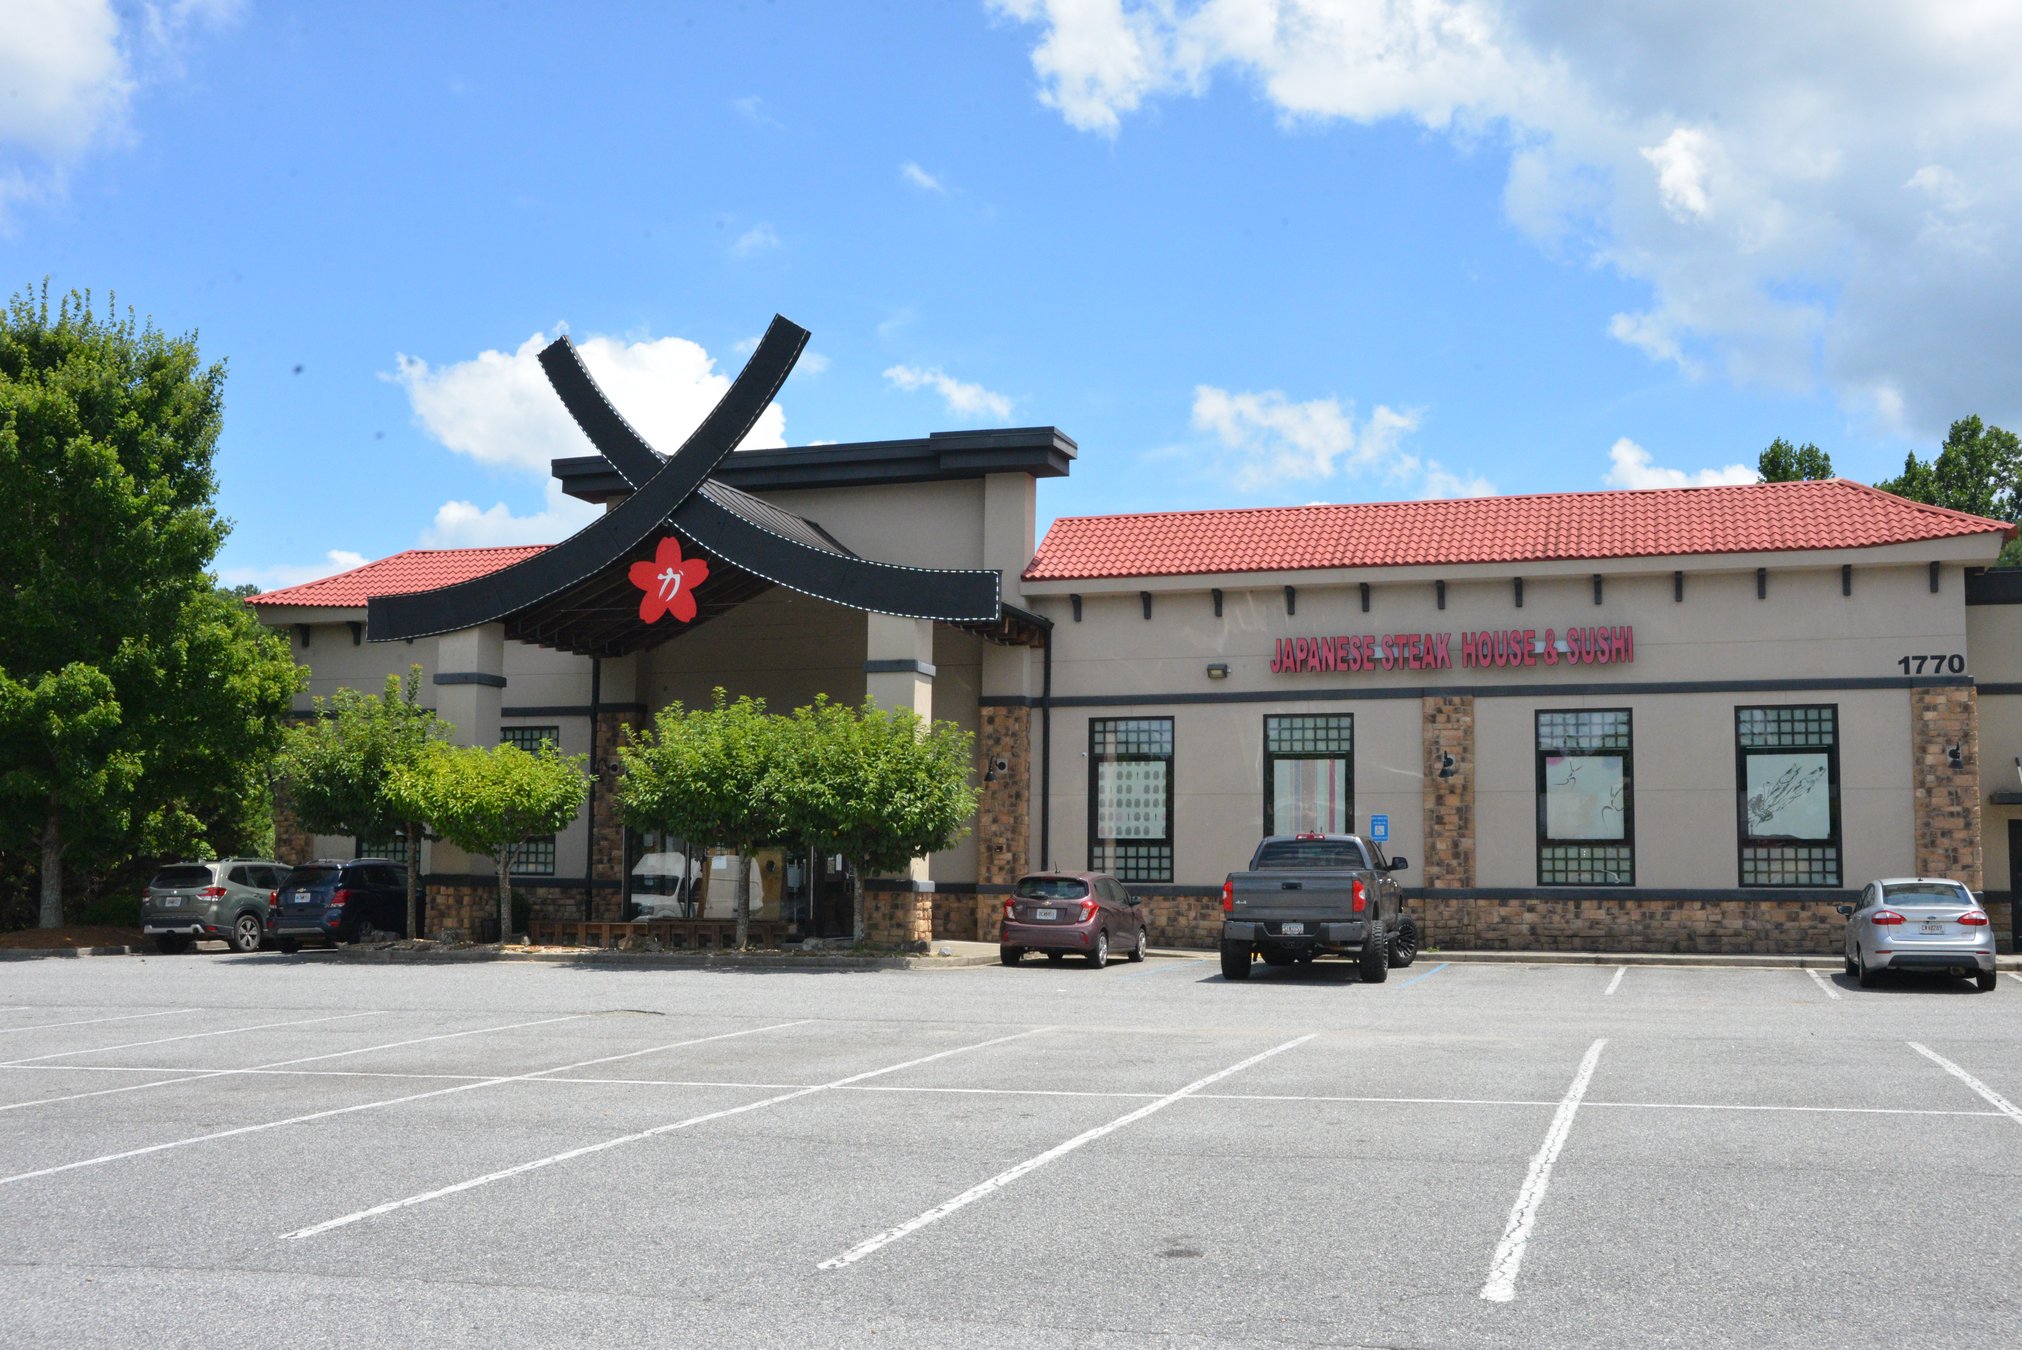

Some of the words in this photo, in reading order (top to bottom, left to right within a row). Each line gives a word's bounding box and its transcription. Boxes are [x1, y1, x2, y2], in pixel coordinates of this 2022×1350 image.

[1269, 634, 1376, 673] JAPANESE
[1381, 632, 1453, 671] STEAK
[1461, 629, 1537, 669] HOUSE
[1543, 628, 1559, 666] &
[1566, 625, 1634, 665] SUSHI
[1897, 653, 1965, 675] 1770
